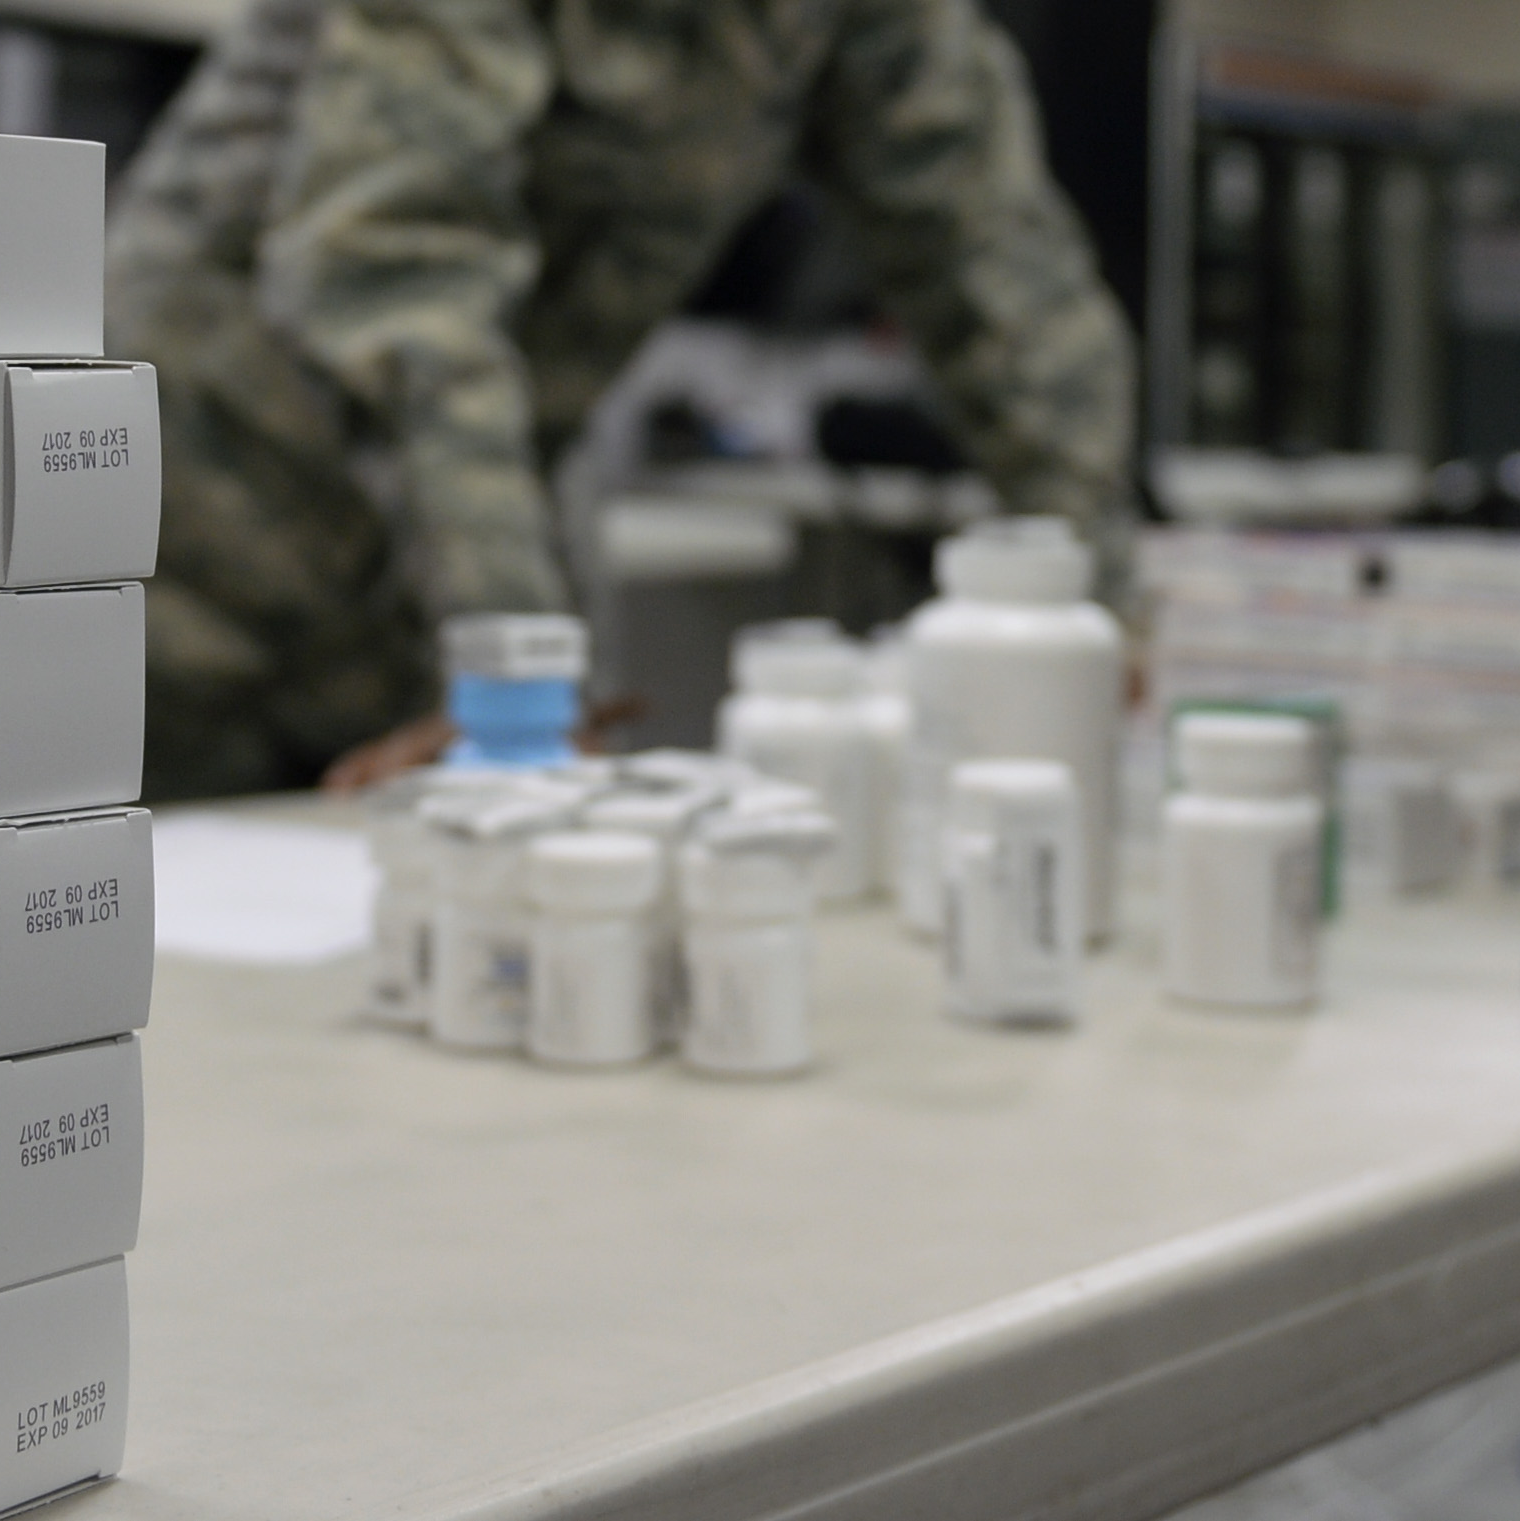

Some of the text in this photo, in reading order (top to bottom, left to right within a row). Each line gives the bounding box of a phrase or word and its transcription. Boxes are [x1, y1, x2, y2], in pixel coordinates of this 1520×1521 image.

[42, 428, 127, 451] EXP 09 2017
[44, 449, 128, 472] LOT ML9559
[25, 879, 118, 911] EXP 09 2017
[26, 901, 118, 933] LOT ML9559
[20, 1104, 108, 1145] EXP 09 2017
[21, 1126, 109, 1166] LOT ML9559
[18, 1381, 105, 1430] LOT ML9559
[17, 1402, 106, 1453] EXP 09 2017
